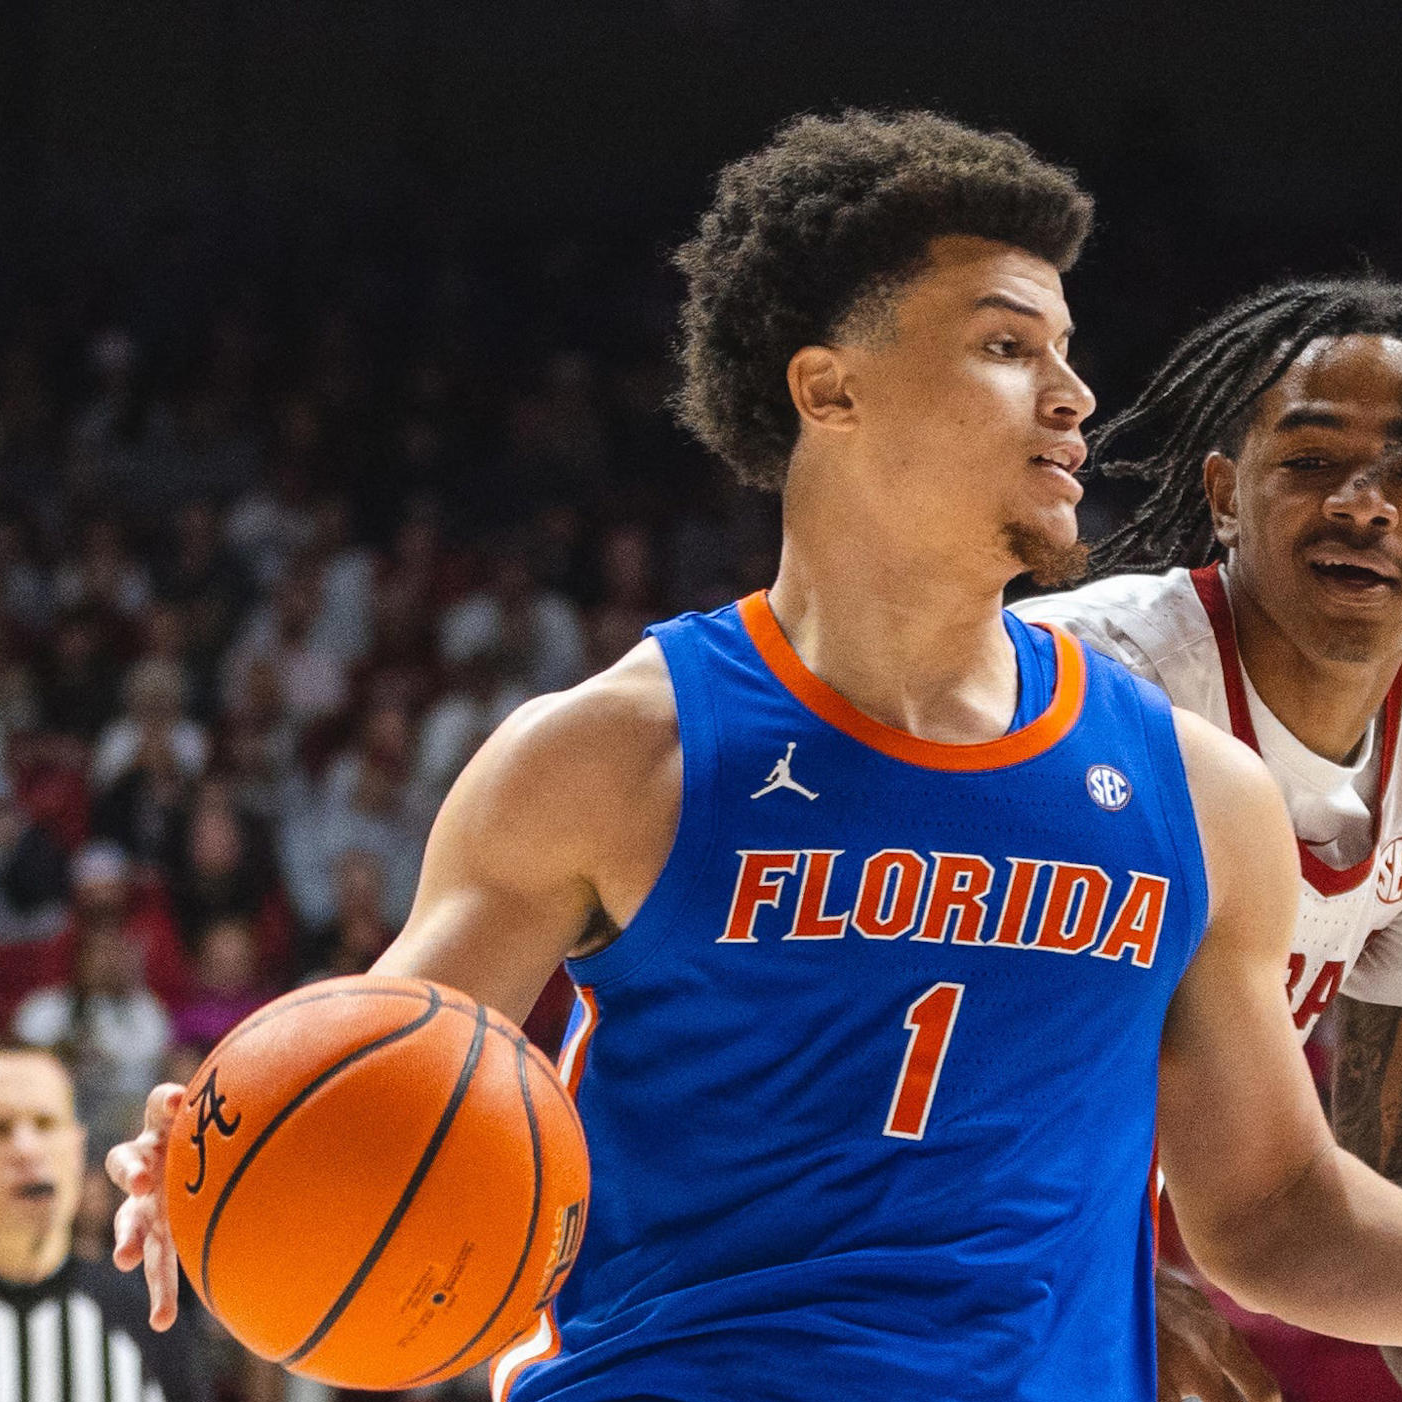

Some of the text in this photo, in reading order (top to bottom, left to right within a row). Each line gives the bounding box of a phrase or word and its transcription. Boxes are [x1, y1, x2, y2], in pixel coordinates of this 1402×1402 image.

[1088, 767, 1130, 809] SEC
[715, 849, 1170, 969] FLORIDA
[882, 981, 966, 1141] 1
